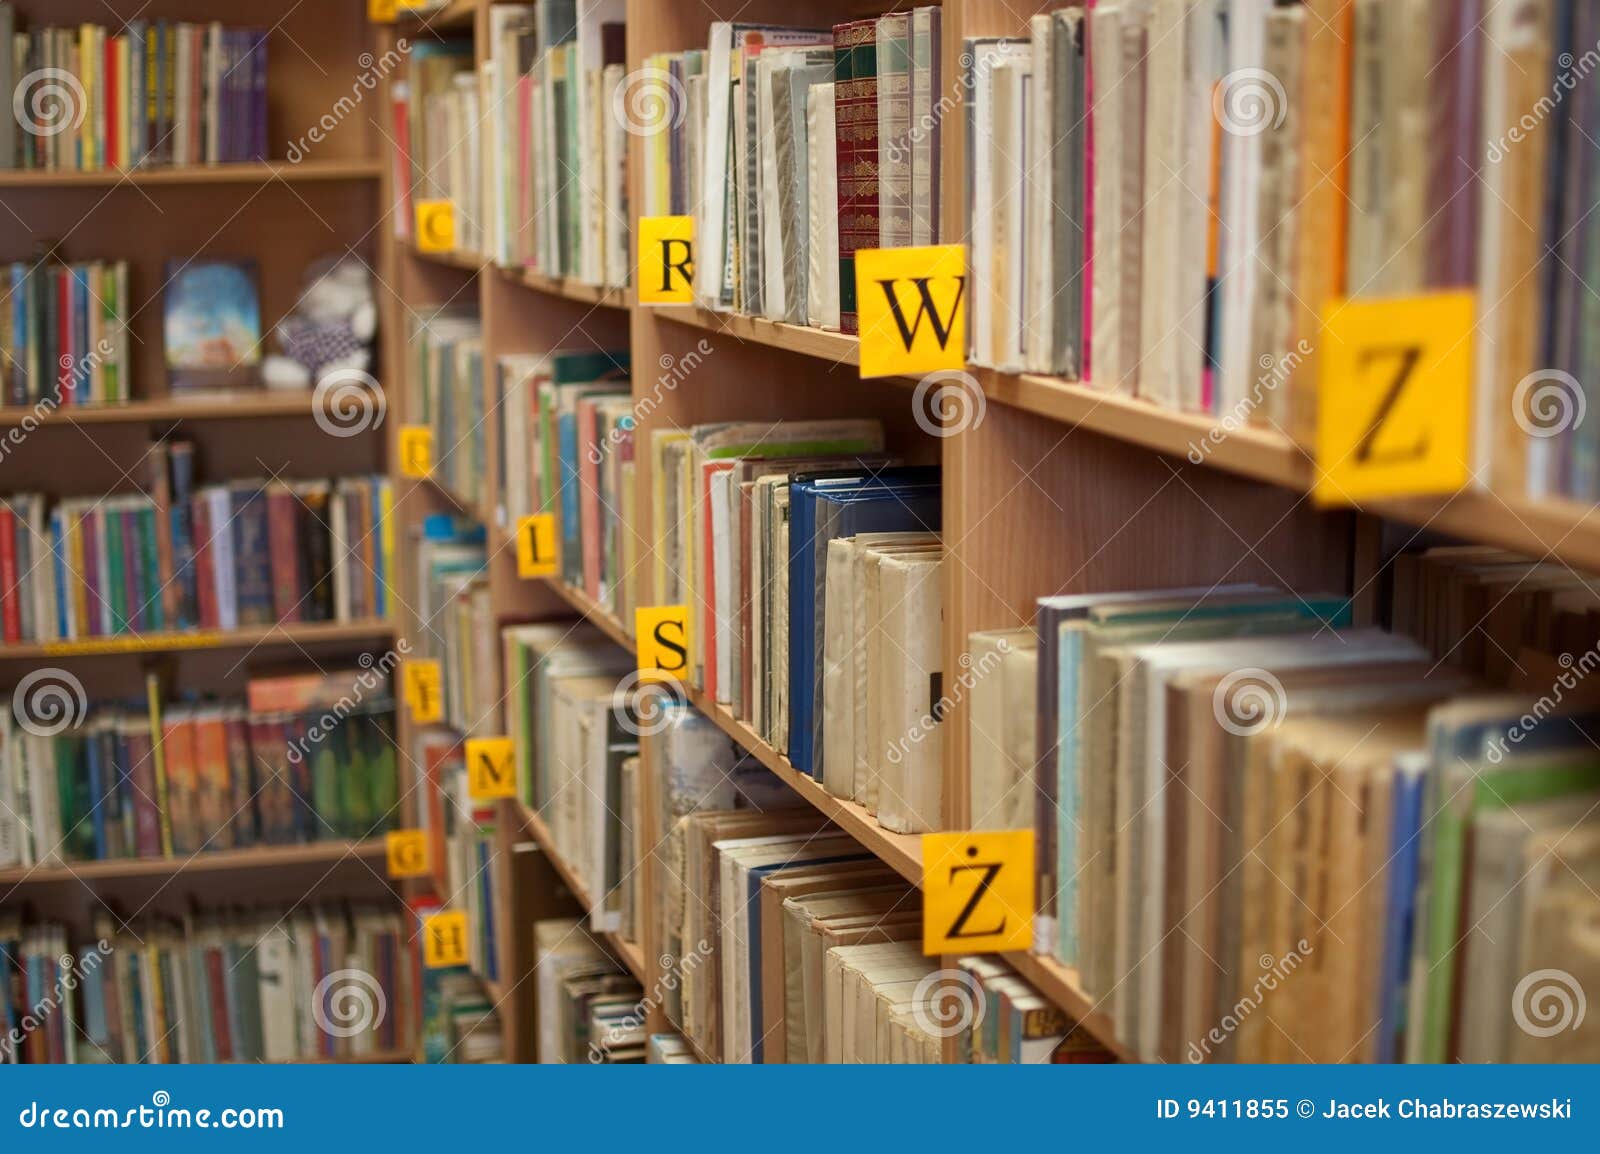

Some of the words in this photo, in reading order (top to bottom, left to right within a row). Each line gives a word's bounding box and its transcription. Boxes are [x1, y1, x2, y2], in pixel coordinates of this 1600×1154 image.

[656, 238, 696, 292] R
[873, 275, 965, 354] W
[1353, 341, 1432, 468] Z
[526, 524, 556, 565] L
[653, 619, 687, 671] S
[478, 752, 515, 789] M
[393, 841, 424, 871] G
[944, 845, 1007, 940] Ż
[432, 923, 464, 961] H
